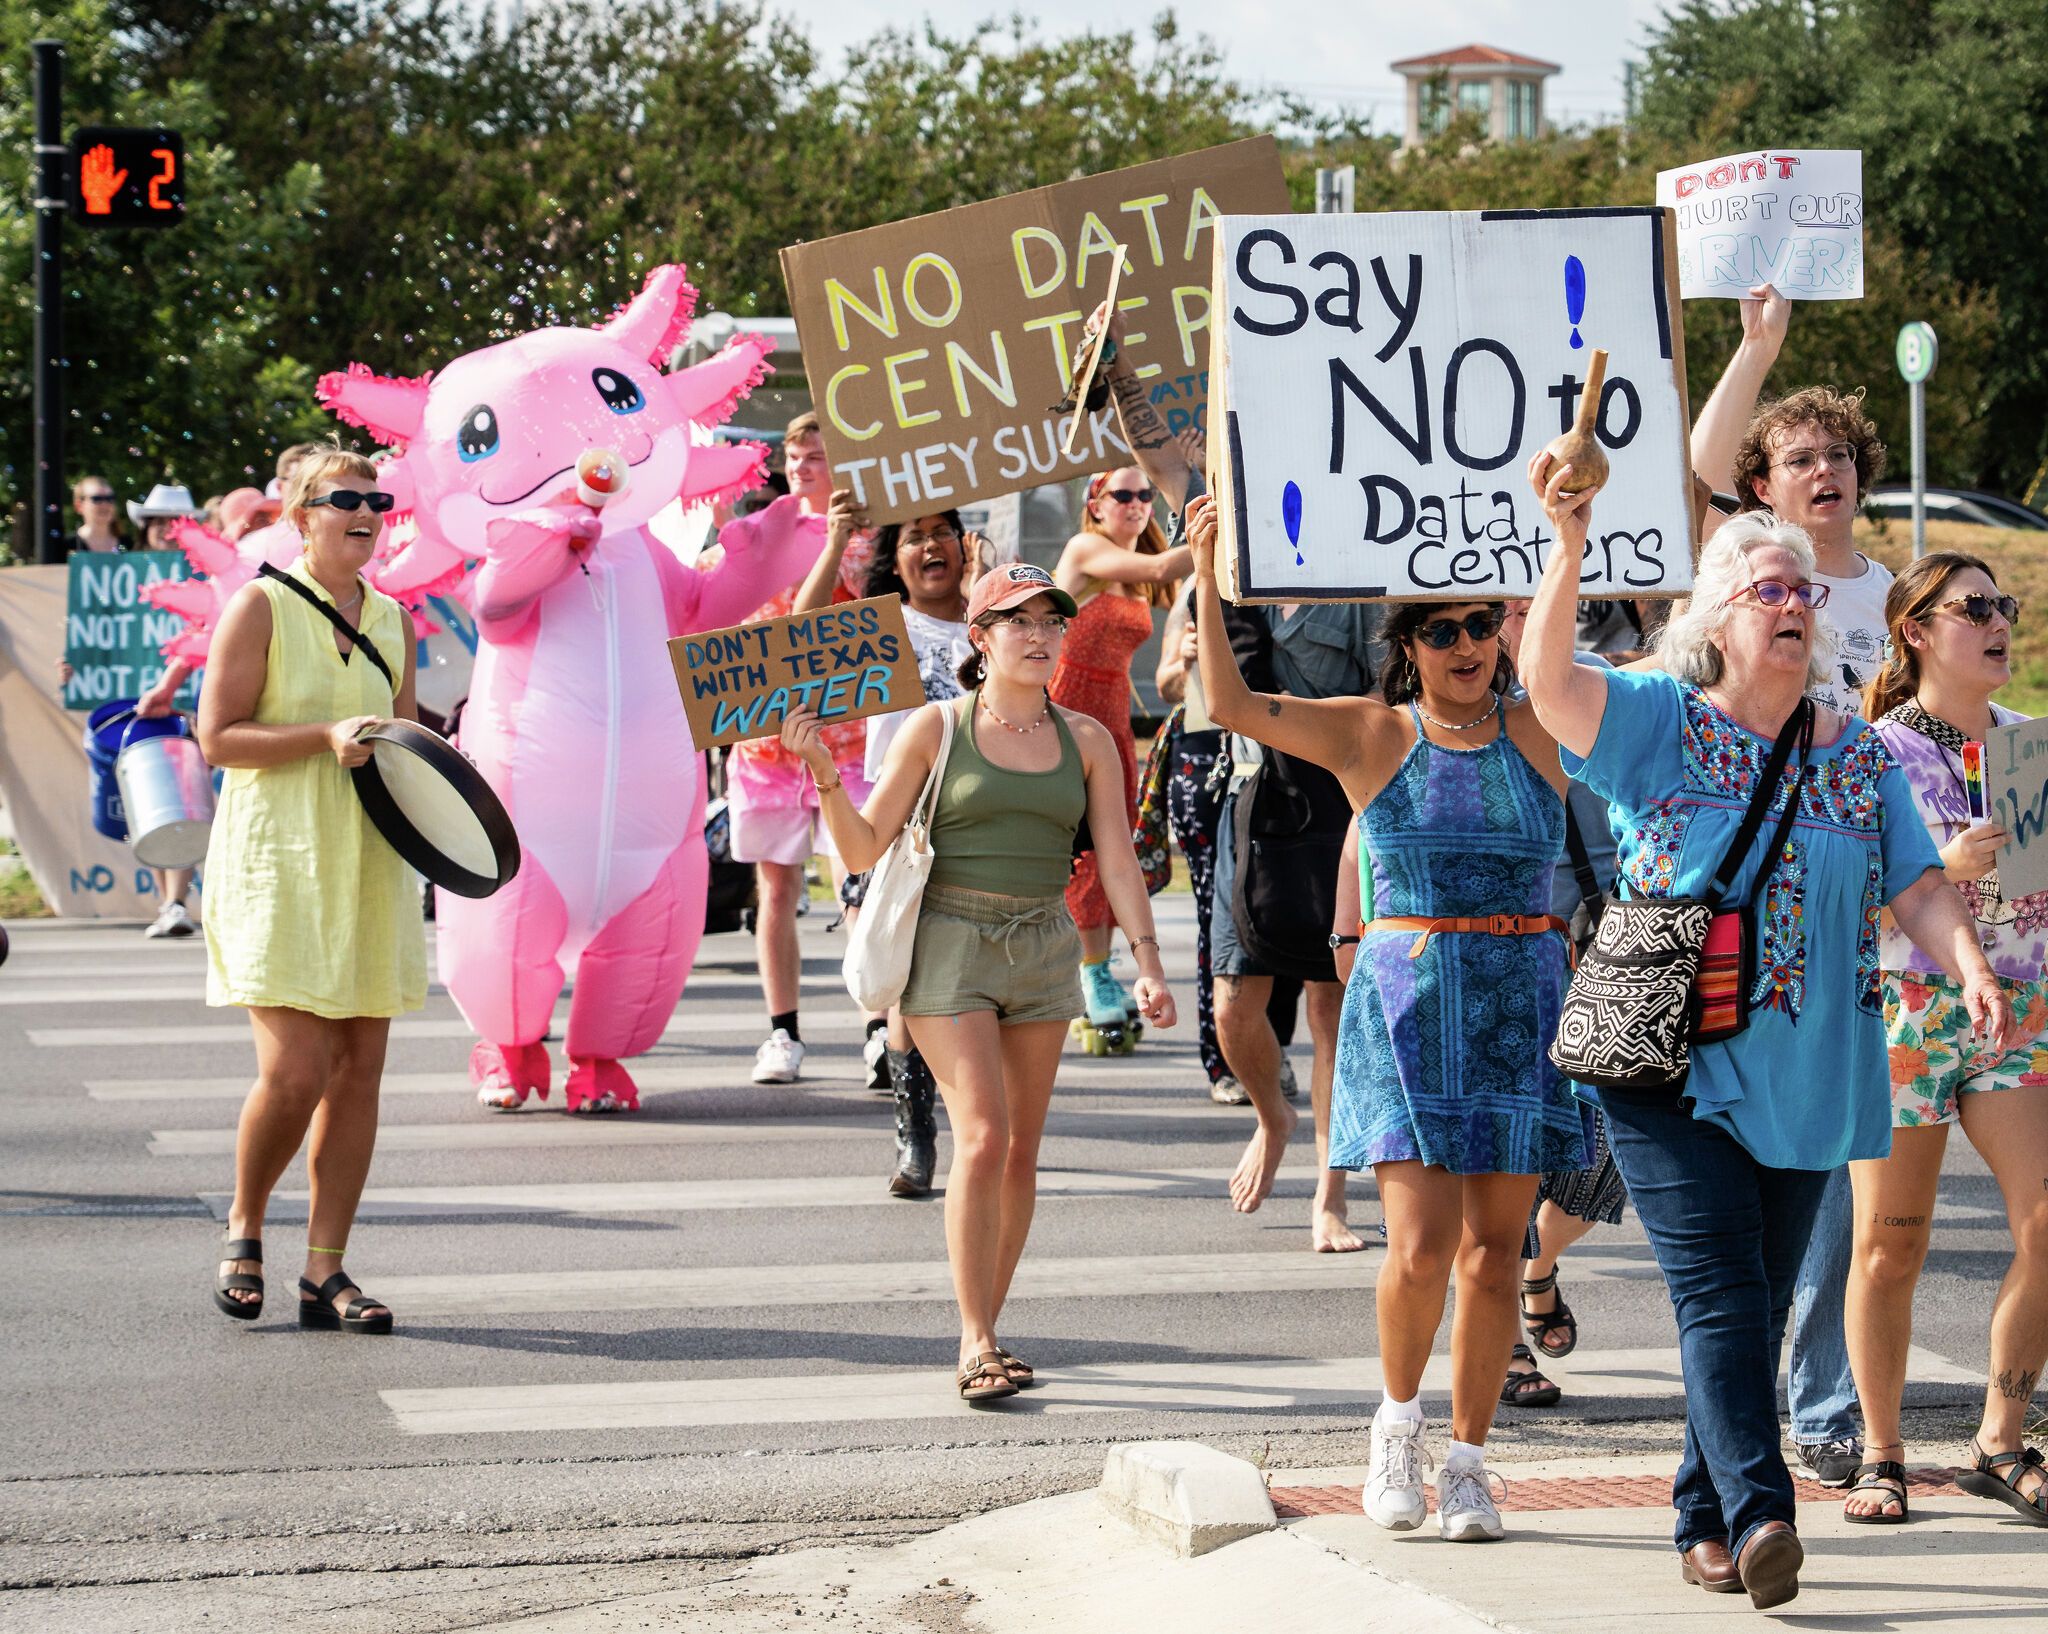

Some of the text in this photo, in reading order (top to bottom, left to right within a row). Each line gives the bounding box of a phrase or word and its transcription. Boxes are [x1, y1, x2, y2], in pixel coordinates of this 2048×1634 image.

[148, 149, 175, 210] 2
[1789, 193, 1862, 226] OUR
[824, 187, 1221, 351] NO DATA
[1700, 233, 1845, 288] RIVER
[1233, 228, 1422, 363] Say
[1328, 337, 1642, 474] NO to
[834, 407, 1131, 507] THEY SUCK
[1359, 477, 1520, 544] Data
[80, 562, 137, 608] NO
[69, 613, 136, 649] NOT
[685, 607, 879, 669] DON'T MESS
[68, 664, 133, 701] NOT
[693, 634, 900, 699] WITH TEXAS
[711, 665, 892, 736] WATER
[70, 863, 114, 894] NO
